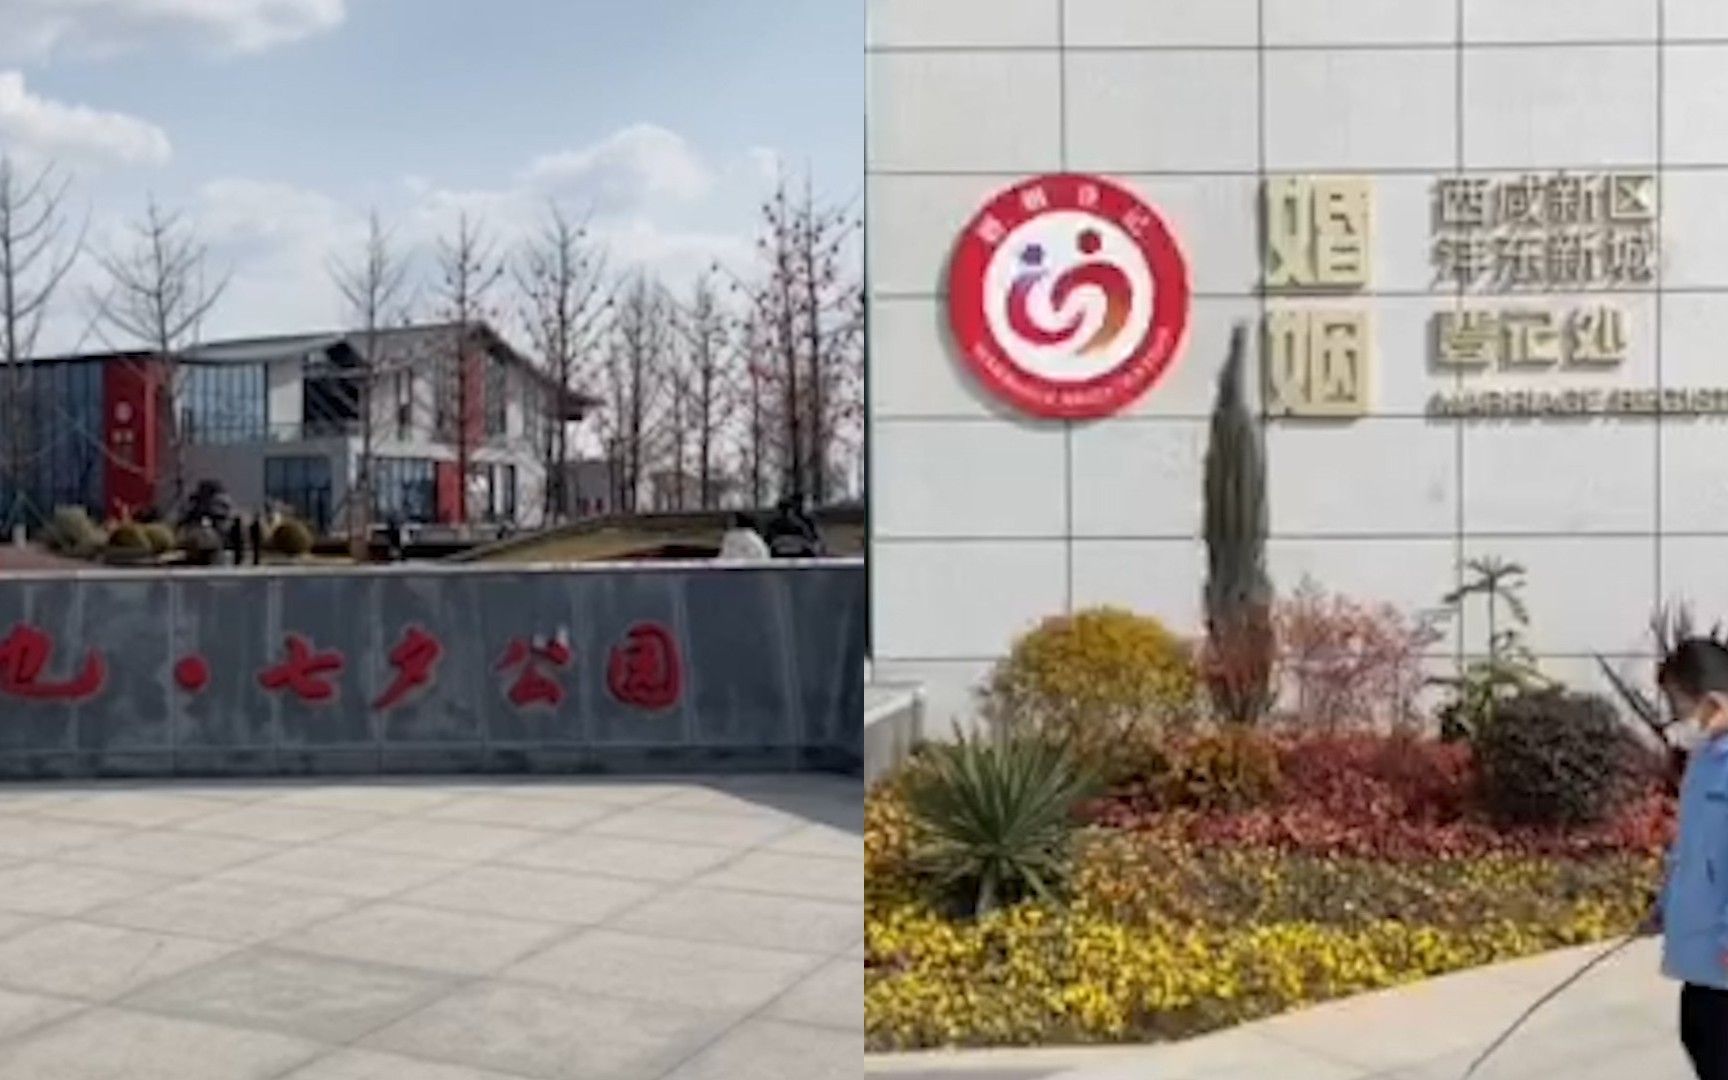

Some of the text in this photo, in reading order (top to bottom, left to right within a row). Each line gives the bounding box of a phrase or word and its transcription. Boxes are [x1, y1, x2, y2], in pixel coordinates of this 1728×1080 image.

[1434, 173, 1657, 227] 西咸新区
[1264, 174, 1371, 418] 婚姻
[1432, 309, 1627, 370] 登记处
